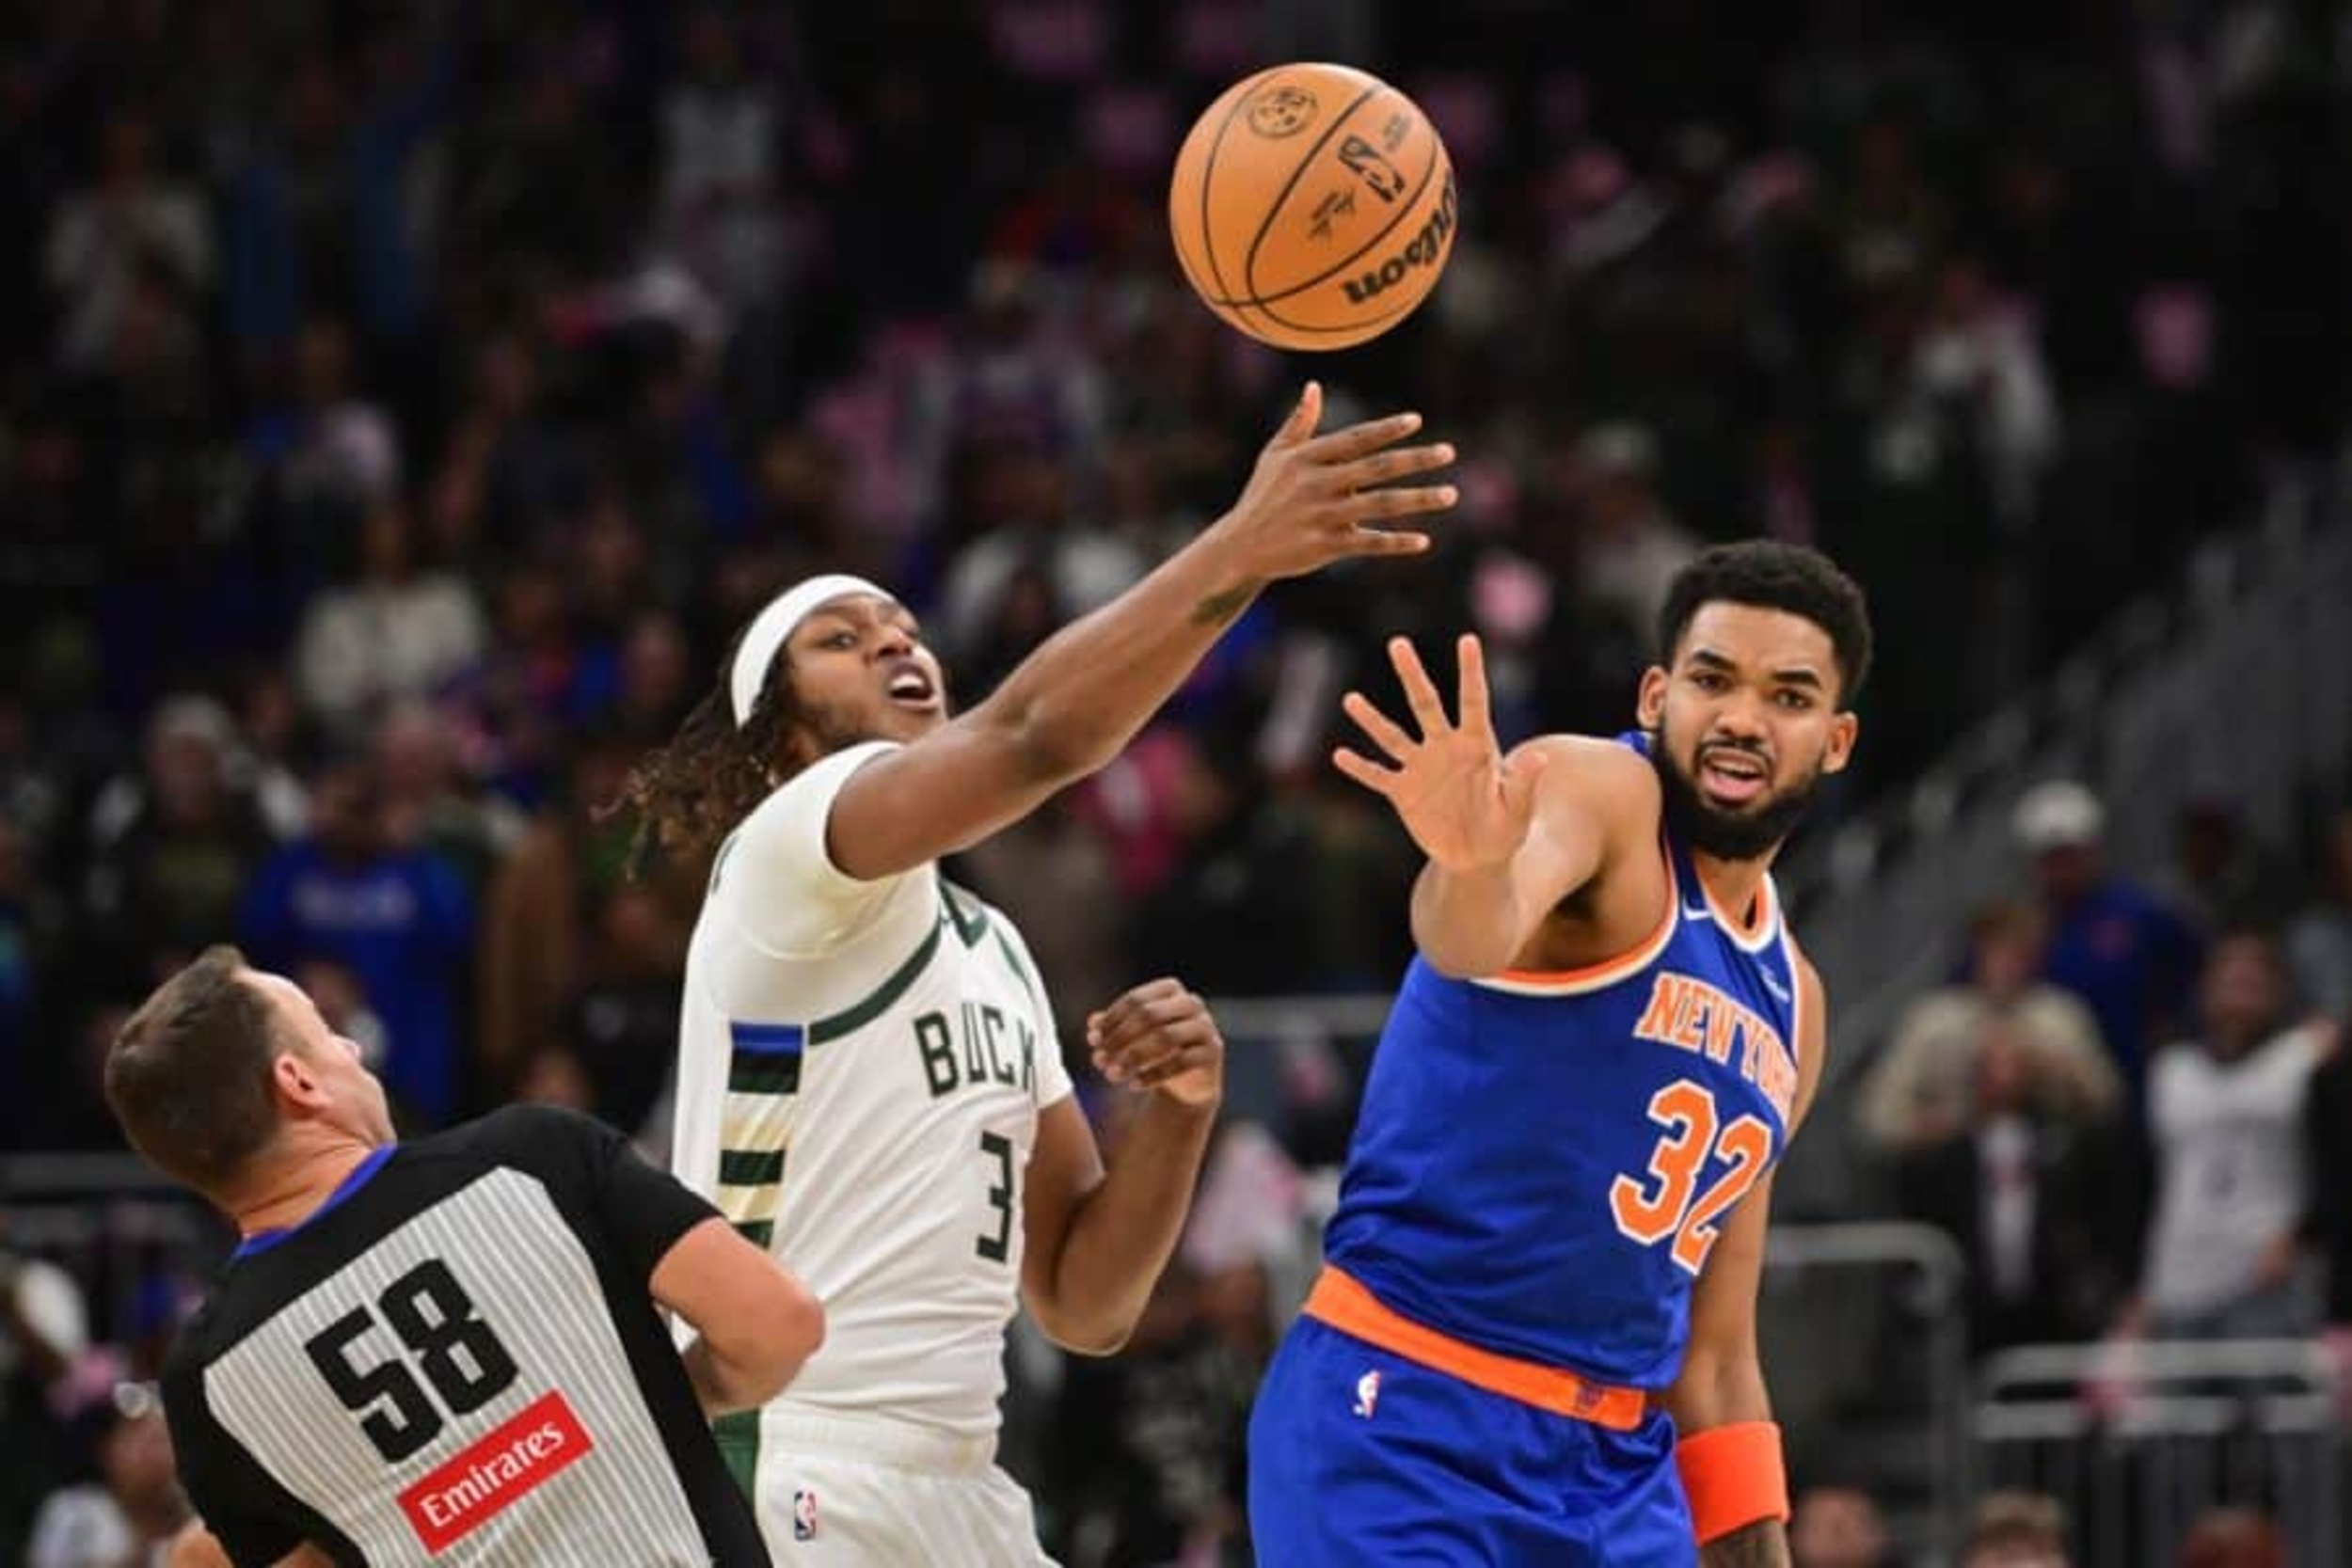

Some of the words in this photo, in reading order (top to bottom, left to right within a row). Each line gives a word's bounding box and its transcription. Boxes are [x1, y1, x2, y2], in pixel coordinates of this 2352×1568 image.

[1633, 970, 1739, 1067] NEW
[977, 1131, 1012, 1263] 3
[1610, 1079, 1772, 1275] 32
[304, 1259, 519, 1464] 58
[419, 1421, 564, 1528] Emirates
